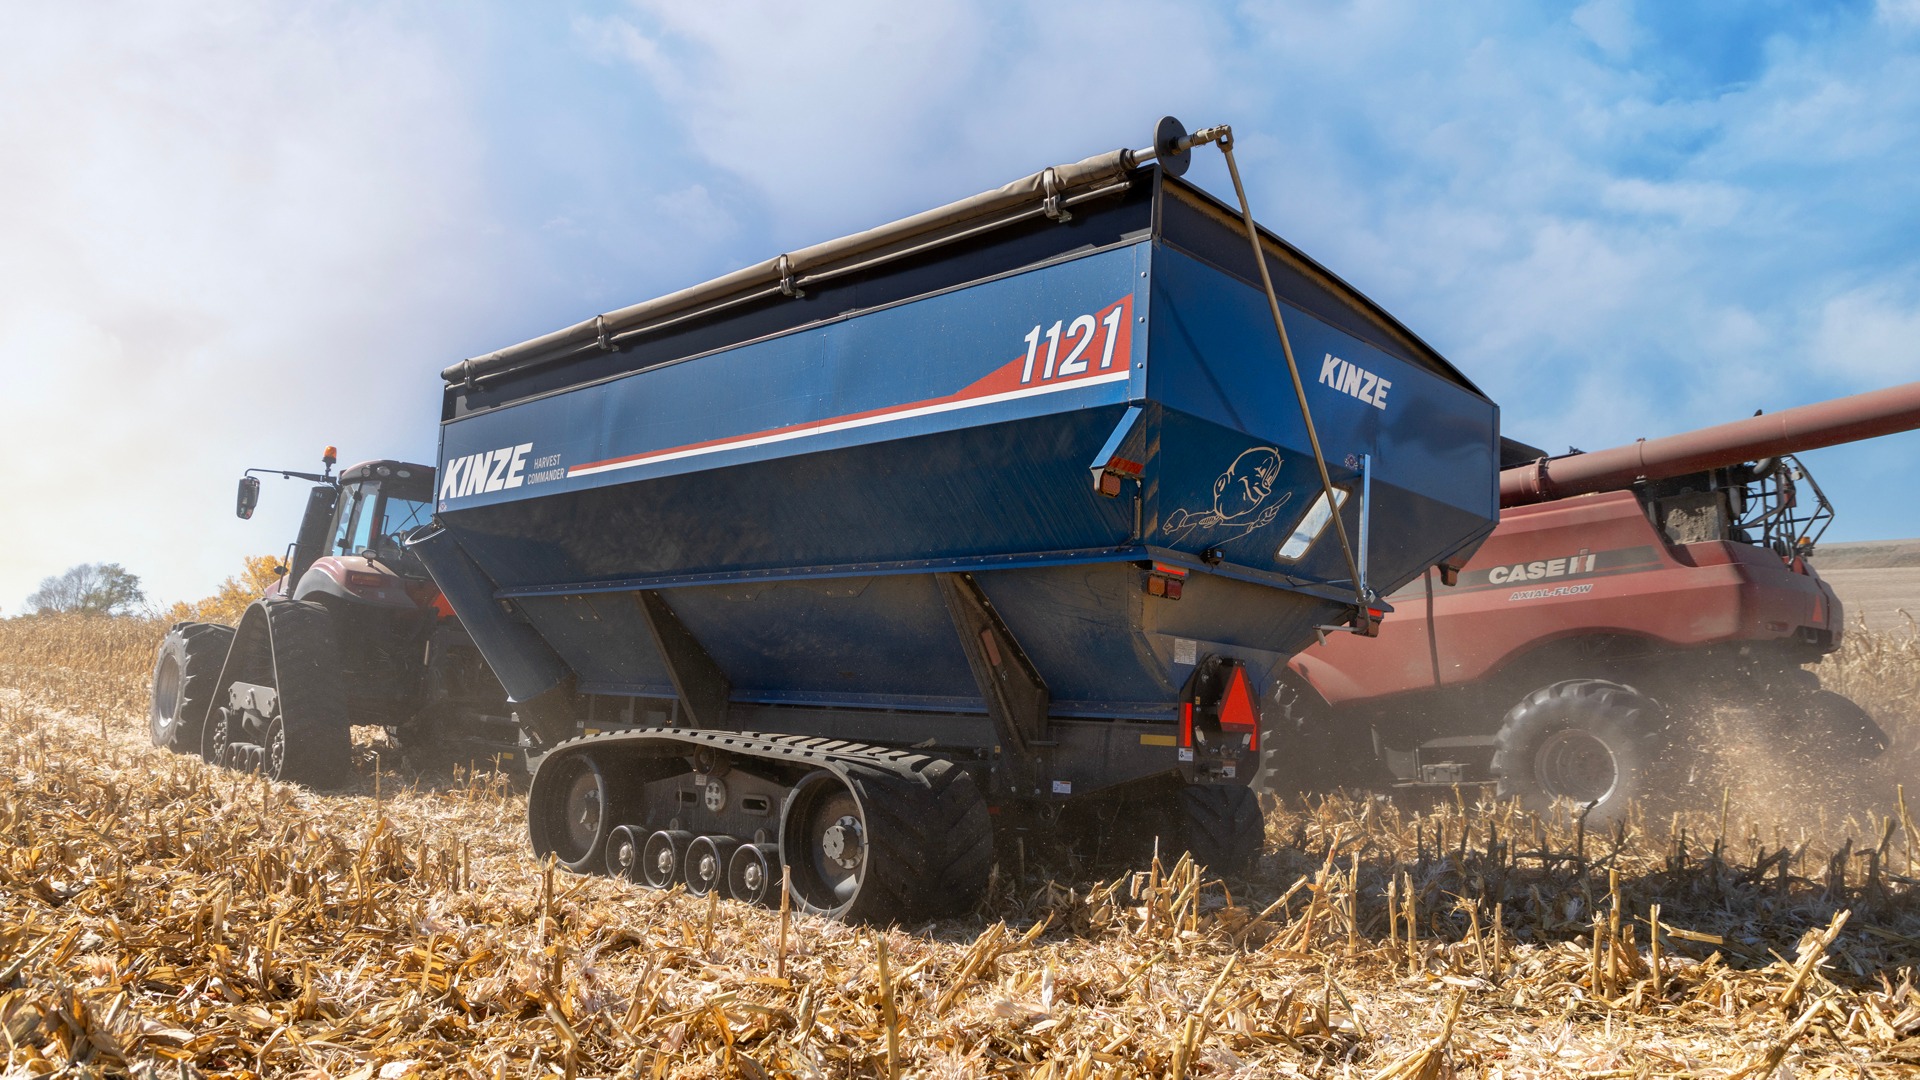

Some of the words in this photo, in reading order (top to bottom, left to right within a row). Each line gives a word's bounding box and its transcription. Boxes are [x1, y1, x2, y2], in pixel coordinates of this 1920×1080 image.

[1020, 304, 1123, 384] 1121
[1318, 352, 1392, 410] KINZE
[438, 443, 533, 500] KINZE
[534, 454, 561, 468] HARVEST
[527, 468, 564, 484] COMMANDER
[1488, 558, 1566, 584] CASE
[1508, 584, 1594, 601] AXIAL-FLOW
